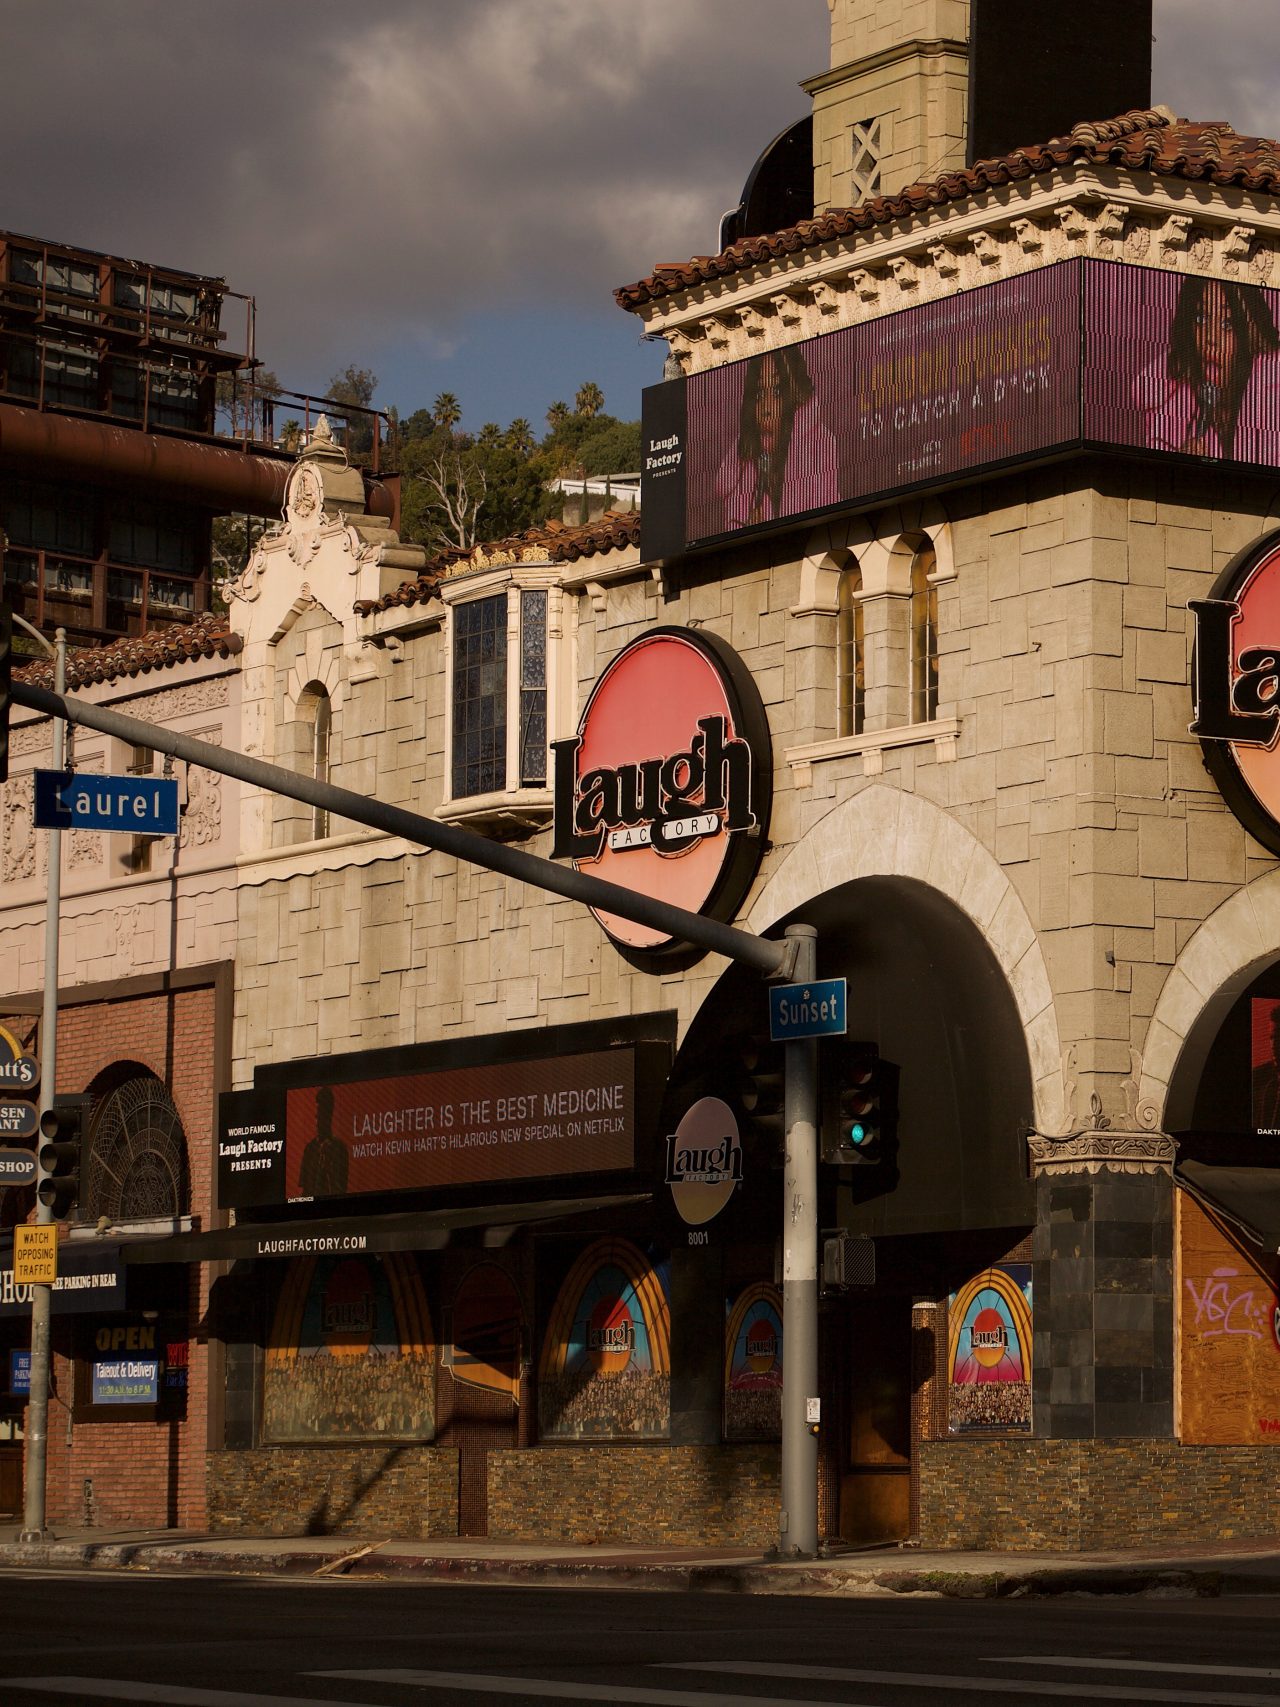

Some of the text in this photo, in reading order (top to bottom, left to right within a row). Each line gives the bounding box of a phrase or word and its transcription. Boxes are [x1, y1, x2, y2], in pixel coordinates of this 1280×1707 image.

[860, 414, 884, 439] TO
[894, 391, 960, 430] CATCH
[972, 384, 983, 409] A
[650, 434, 679, 452] Laugh
[646, 452, 682, 469] Factory
[652, 468, 676, 478] PRESENTS
[549, 712, 757, 859] Laugh
[56, 788, 160, 818] Laurel
[612, 816, 714, 848] FACTORY
[780, 994, 837, 1026] Sunset
[353, 1085, 624, 1137] LAUGHTER IS THE BEST MEDICINE
[228, 1124, 276, 1136] WORLD FAMOUS
[352, 1117, 625, 1158] WATCH KEVIN HART'S HILARIOUS NEW SPECIAL ON NETFLIX
[219, 1138, 283, 1158] Laugh Factory
[231, 1158, 272, 1172] PRESENTS
[665, 1134, 743, 1184] Laugh
[24, 1233, 49, 1243] WATCH
[258, 1236, 367, 1253] LAUGHFACTORY.COM
[688, 1231, 708, 1245] 8001
[17, 1248, 54, 1260] OPPOSING
[19, 1264, 52, 1276] TRAFFIC
[64, 1275, 91, 1290] PARKING
[92, 1274, 99, 1288] IN
[100, 1273, 117, 1287] REAR
[96, 1327, 155, 1350] OPEN
[584, 1319, 638, 1354] Laugh
[970, 1326, 1010, 1348] Laugh
[96, 1362, 156, 1380] Takeout & Delivery
